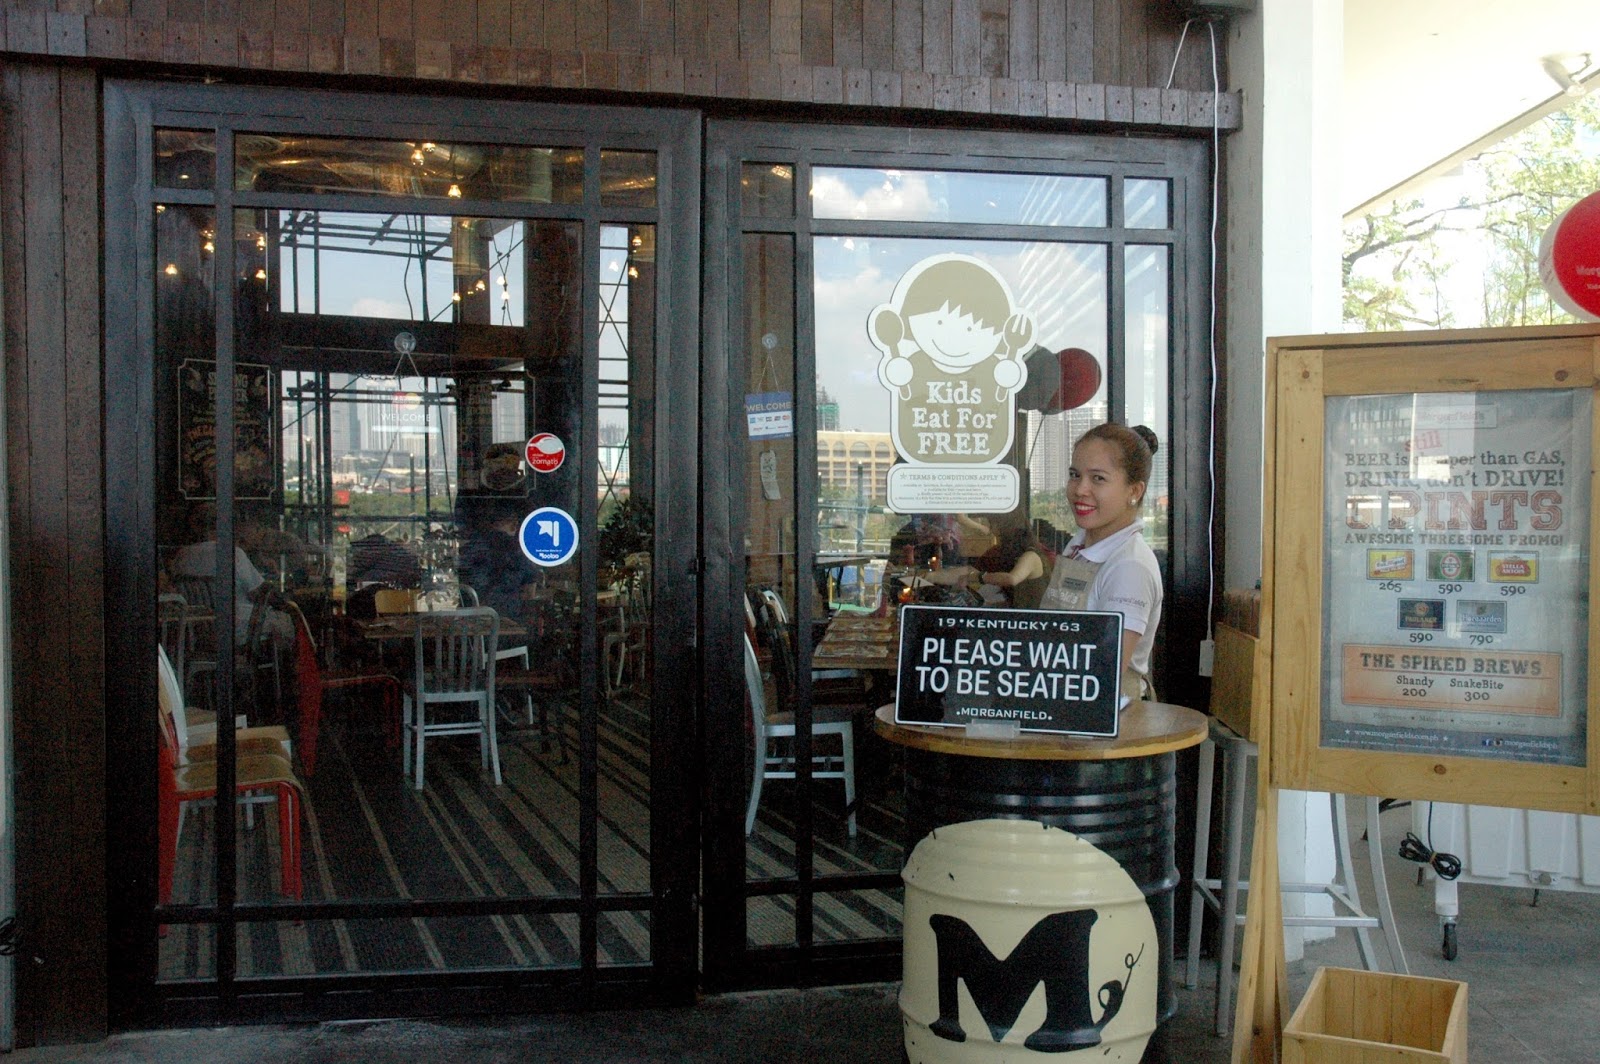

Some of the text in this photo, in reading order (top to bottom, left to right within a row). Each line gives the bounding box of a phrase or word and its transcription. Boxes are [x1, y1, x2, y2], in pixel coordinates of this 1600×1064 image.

[926, 380, 982, 404] Kids
[746, 402, 792, 412] WELCOME
[381, 413, 430, 421] WELCOME
[912, 407, 997, 429] Eat For
[917, 432, 990, 455] FREE
[1345, 453, 1391, 466] BEER
[1395, 453, 1408, 466] is
[1480, 451, 1518, 465] than
[1523, 451, 1565, 467] GAS,
[1485, 470, 1564, 487] DRIVE!
[1388, 490, 1563, 531] PINTS
[1345, 533, 1563, 546] AWESOME THREESOME PROMO!
[1379, 580, 1402, 593] 265
[1438, 583, 1463, 594] 590
[1500, 585, 1526, 597] 590
[938, 617, 1080, 632] 19 KENTUCKY 63
[1409, 632, 1433, 643] 590
[1469, 634, 1494, 645] 790
[922, 637, 1097, 671] PLEASE WAIT
[1360, 652, 1542, 676] THE SPIKED BREWS
[915, 666, 1100, 702] TO BE SEATED
[1396, 675, 1504, 690] Shandy SnakeBite
[1402, 688, 1427, 698] 200
[1464, 691, 1490, 702] 300
[929, 909, 1103, 1053] M
